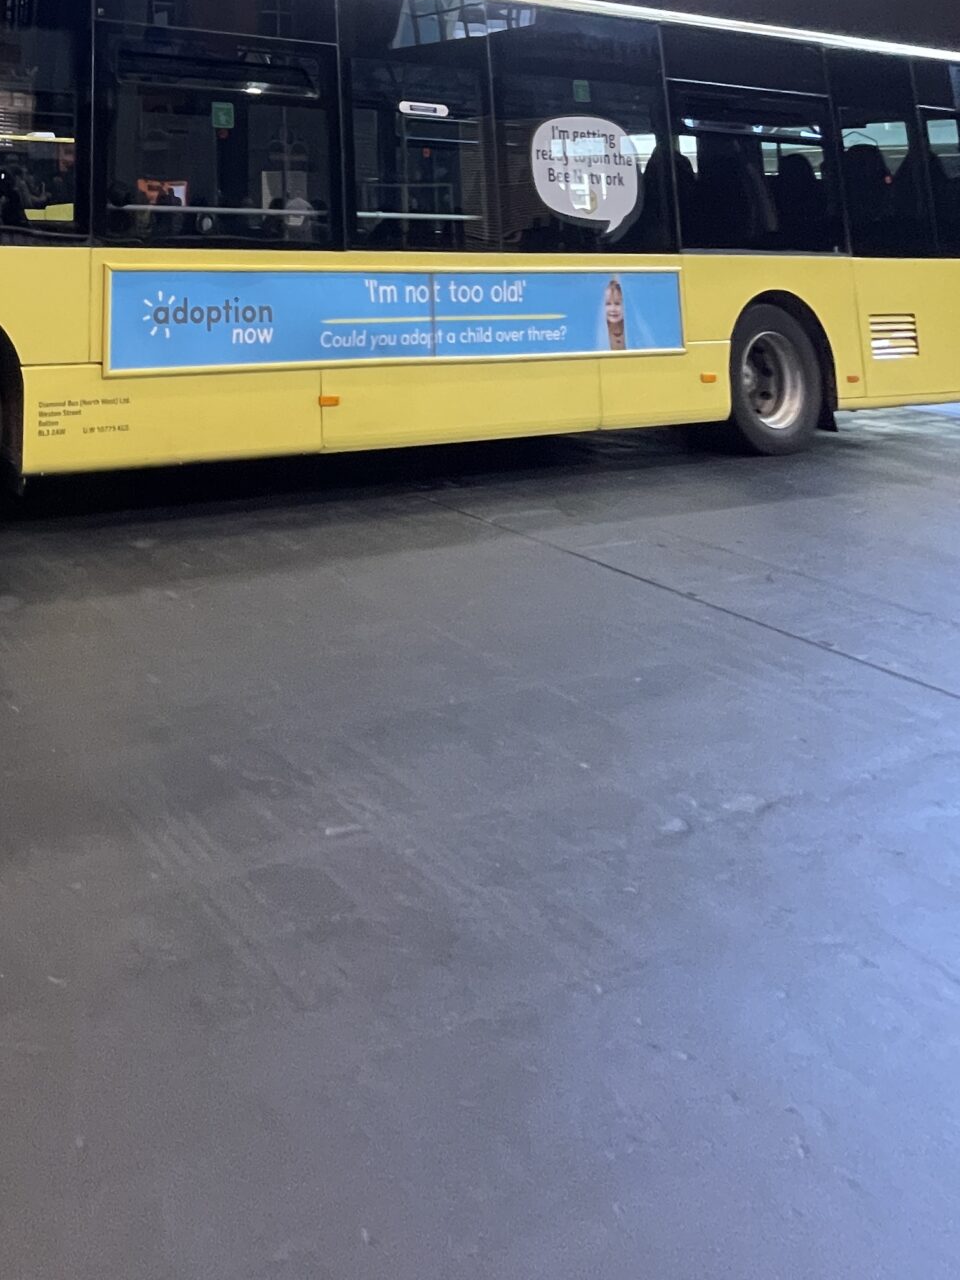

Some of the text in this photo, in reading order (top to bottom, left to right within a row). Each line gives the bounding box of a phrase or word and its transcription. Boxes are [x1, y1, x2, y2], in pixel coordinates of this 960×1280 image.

[551, 125, 569, 140] I'm
[536, 147, 569, 166] reay
[613, 151, 633, 167] the
[547, 167, 625, 186] Bee Ntwork
[405, 280, 441, 304] not
[448, 280, 484, 303] too
[152, 296, 273, 332] adoption
[231, 326, 274, 345] now
[319, 324, 567, 352] Could you adopt a child over three?
